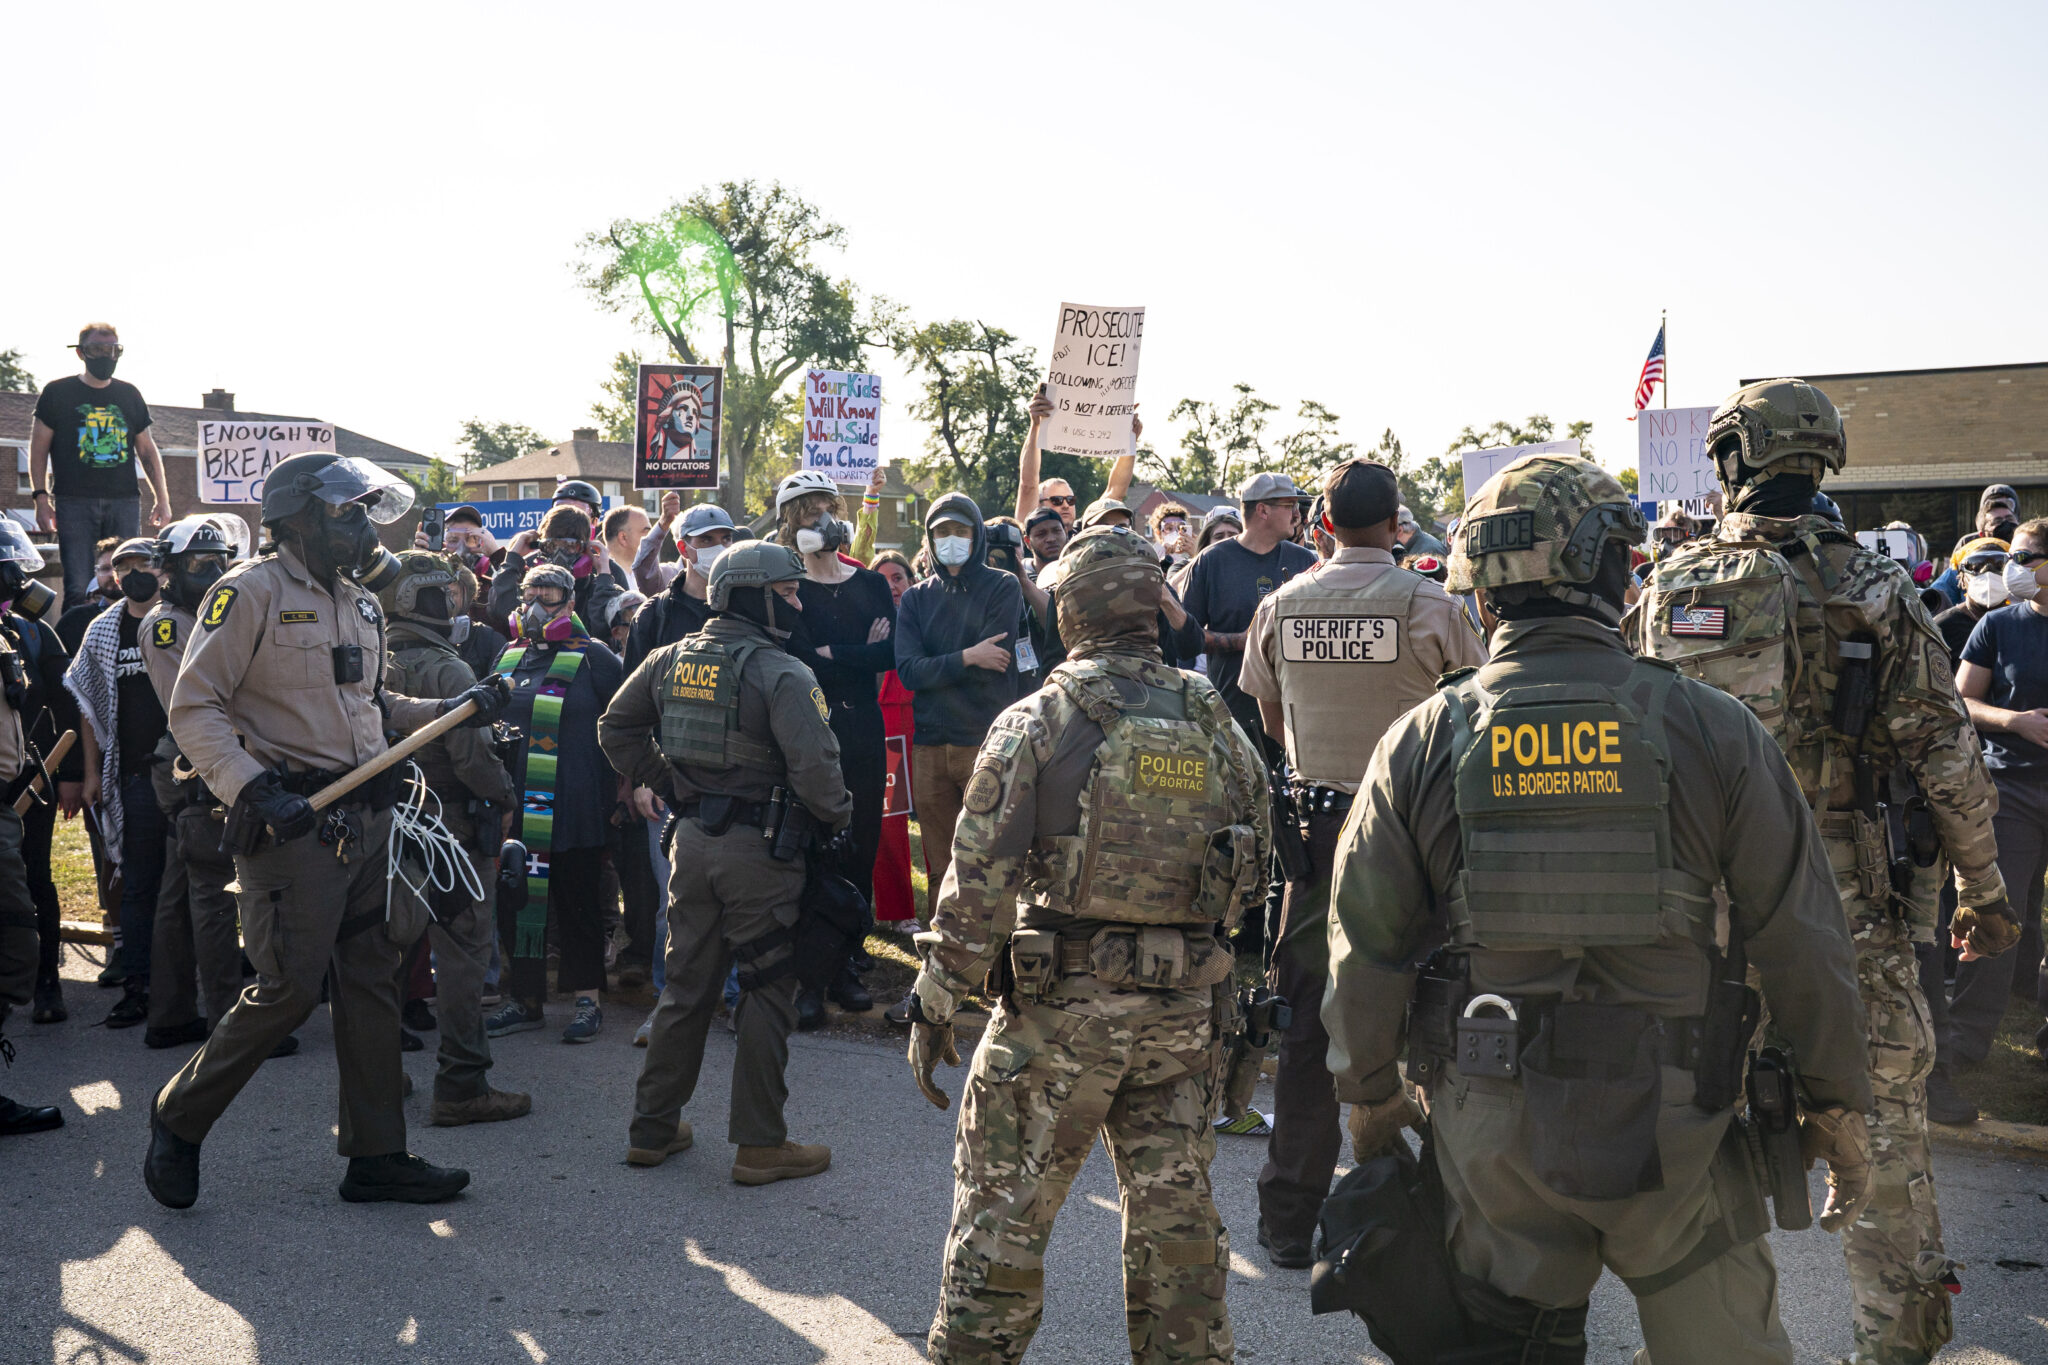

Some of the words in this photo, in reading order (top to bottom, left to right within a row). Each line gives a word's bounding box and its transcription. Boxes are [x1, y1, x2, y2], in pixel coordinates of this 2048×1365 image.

[1061, 308, 1144, 338] PROSECUTE
[1087, 343, 1126, 367] ICE!
[808, 372, 846, 395] Your
[847, 374, 880, 398] Kids
[1048, 372, 1104, 389] FOLLOWING
[808, 397, 834, 418] Will
[837, 397, 877, 420] Know
[1059, 398, 1070, 411] IS
[1075, 403, 1097, 414] NOT
[1097, 406, 1103, 416] A
[1105, 404, 1134, 416] DEFENSE
[203, 423, 300, 445] ENOUGH
[306, 427, 332, 443] TO
[806, 420, 844, 442] Which
[844, 421, 878, 446] Side
[1649, 411, 1677, 439] NO
[806, 444, 833, 467] You
[837, 445, 877, 468] Chose
[1649, 440, 1678, 467] NO
[646, 462, 660, 471] NO
[662, 462, 711, 471] DICTATORS
[821, 470, 872, 480] OLIDARITY
[1650, 471, 1679, 495] NO
[481, 512, 514, 529] OUTH
[1468, 517, 1530, 554] POLICE
[1293, 619, 1384, 639] SHERIFF'S
[1302, 641, 1374, 660] POLICE
[673, 661, 720, 687] POLICE
[680, 686, 697, 699] BORDER
[698, 688, 715, 701] PATROL
[1491, 721, 1622, 768] POLICE
[1140, 754, 1205, 778] POLICE
[1159, 776, 1204, 791] BORTAC
[1492, 773, 1516, 797] U.S.
[1518, 771, 1571, 795] BORDER
[1573, 770, 1623, 794] PATROL
